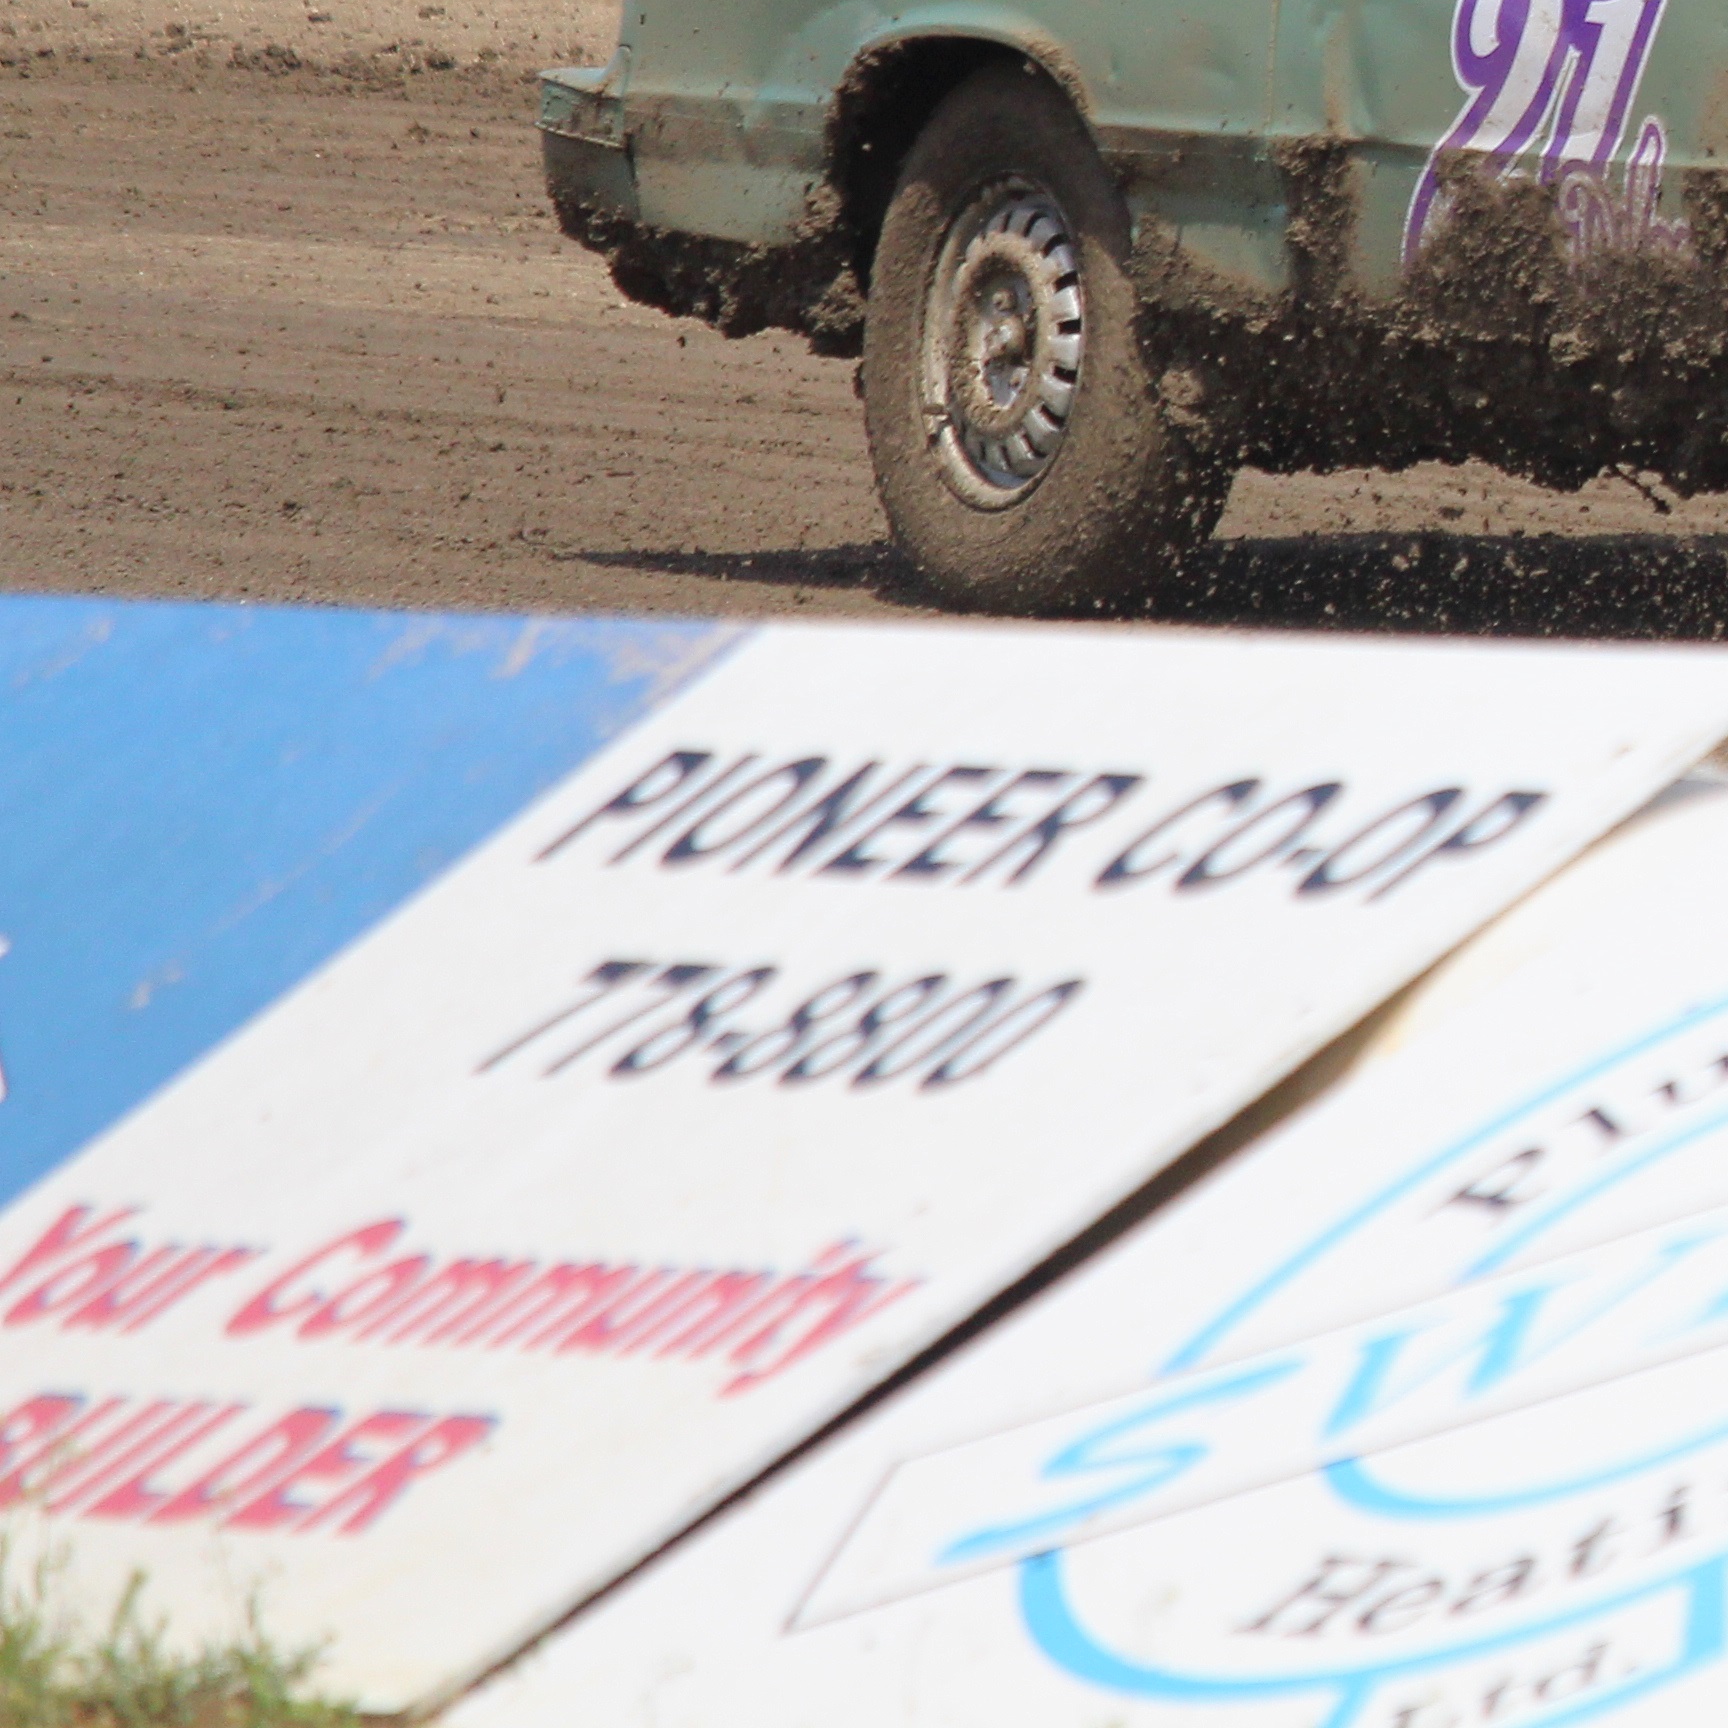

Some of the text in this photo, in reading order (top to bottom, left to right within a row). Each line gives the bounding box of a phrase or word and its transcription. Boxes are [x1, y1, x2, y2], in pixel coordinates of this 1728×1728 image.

[535, 748, 1550, 902] PIONEER CO-OP
[476, 960, 1088, 1090] 778-8800
[0, 1204, 925, 1394] Your Community
